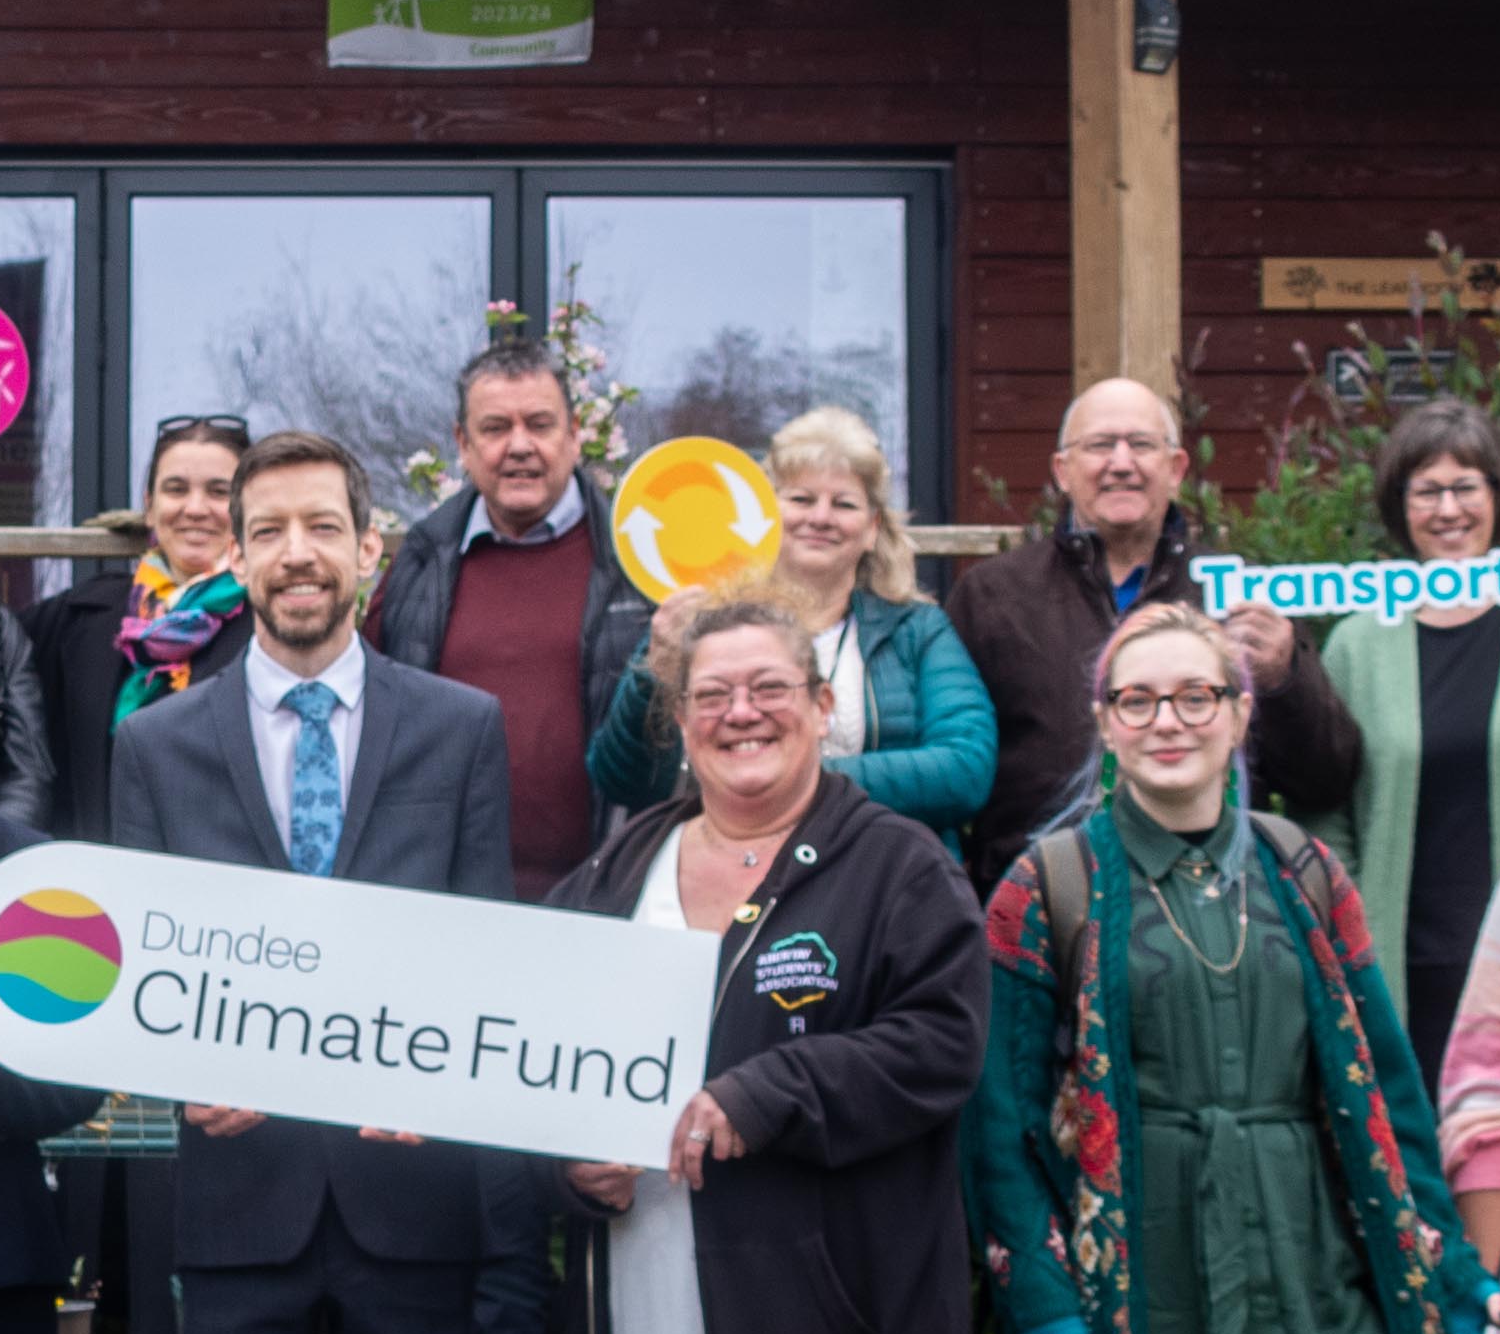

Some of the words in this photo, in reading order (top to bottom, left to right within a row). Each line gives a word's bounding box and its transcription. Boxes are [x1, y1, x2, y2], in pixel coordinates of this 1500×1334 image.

[469, 41, 557, 57] Community
[140, 910, 322, 974] Dundee
[132, 969, 451, 1074] Climate
[469, 1014, 677, 1106] Fund
